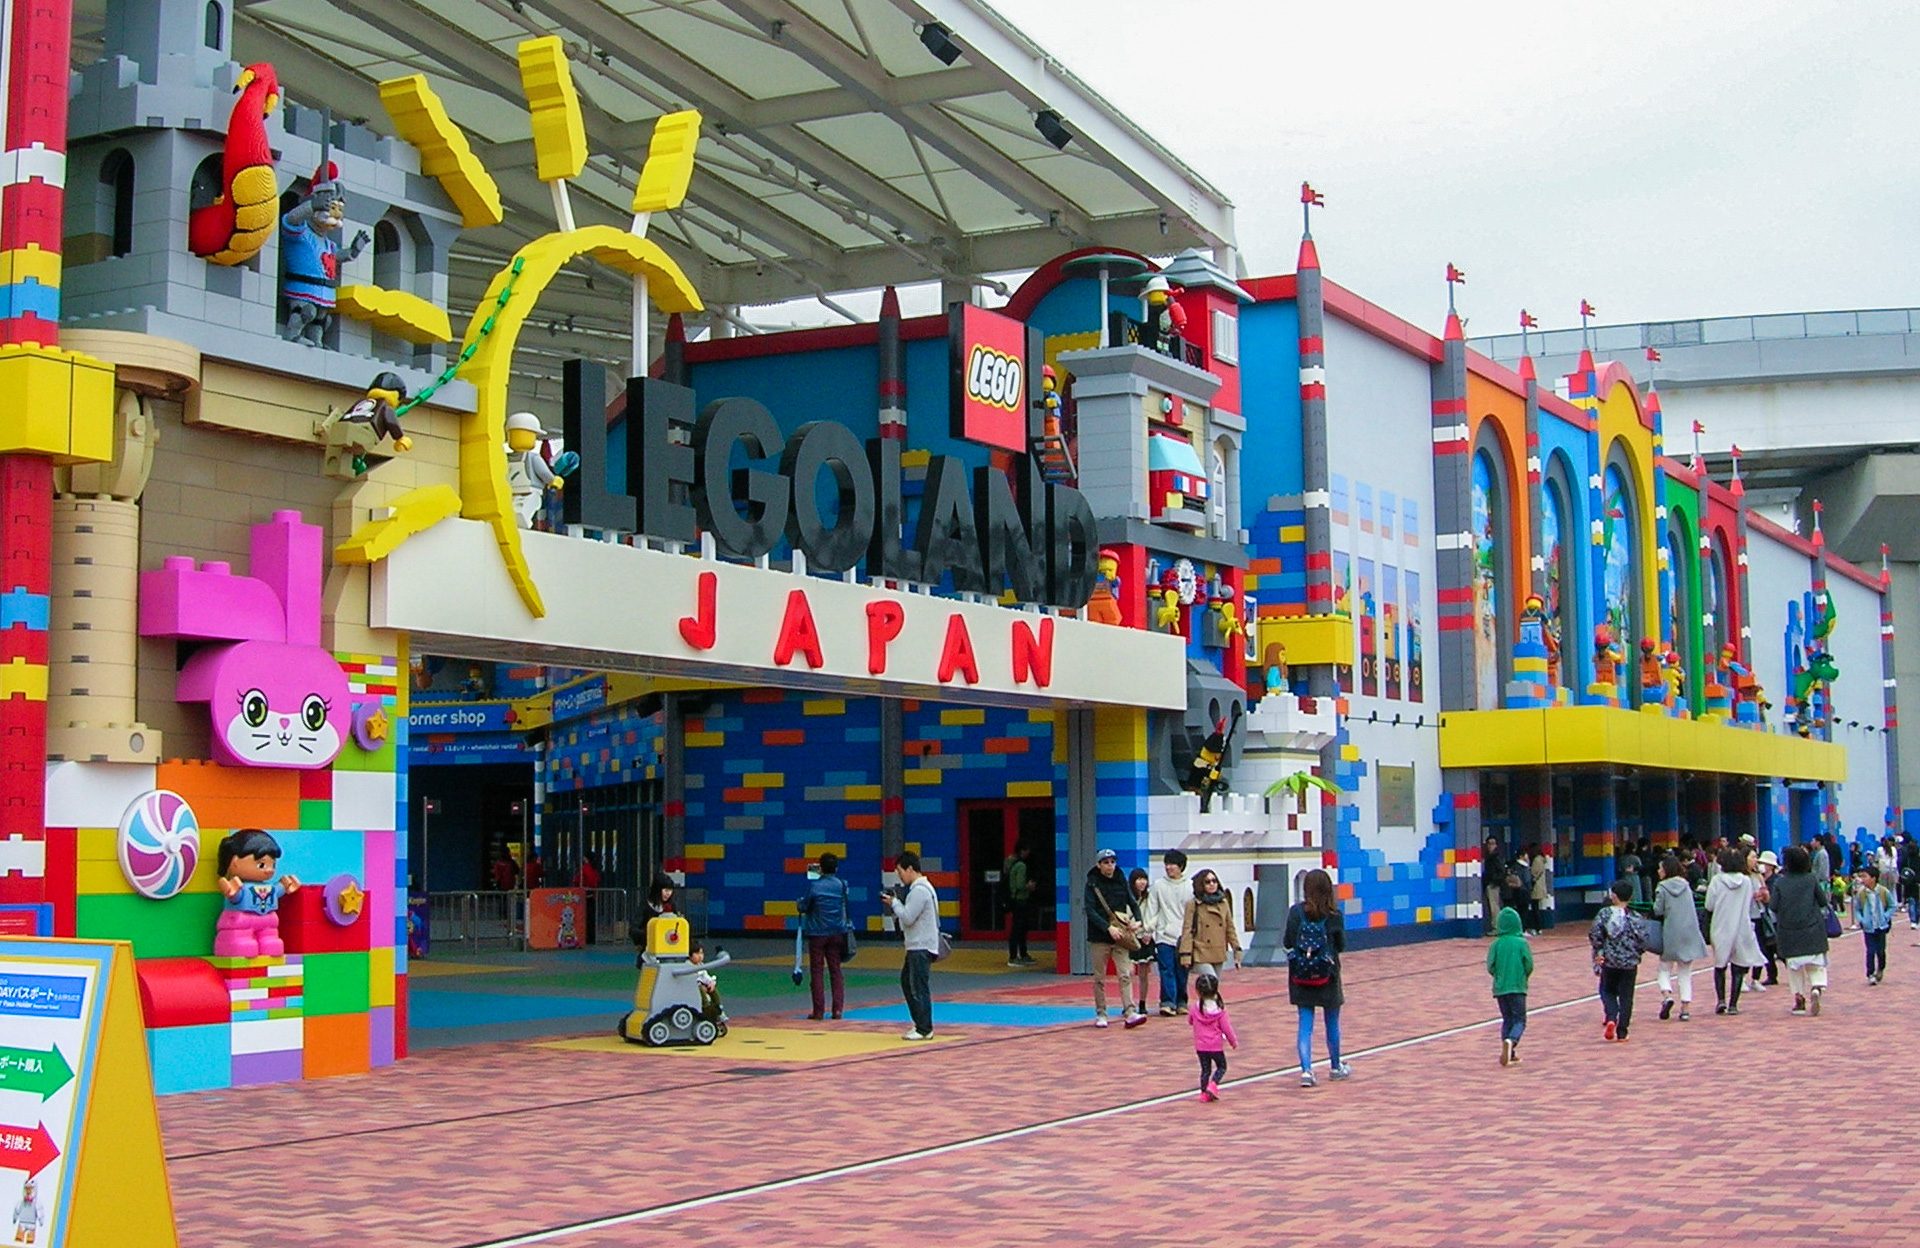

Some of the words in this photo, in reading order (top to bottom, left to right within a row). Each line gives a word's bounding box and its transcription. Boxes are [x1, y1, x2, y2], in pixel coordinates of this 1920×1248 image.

[969, 349, 1020, 406] LEGO
[562, 359, 1099, 609] LEGOLAND
[678, 571, 1055, 689] JAPAN
[409, 711, 447, 726] orner
[450, 709, 486, 727] shop
